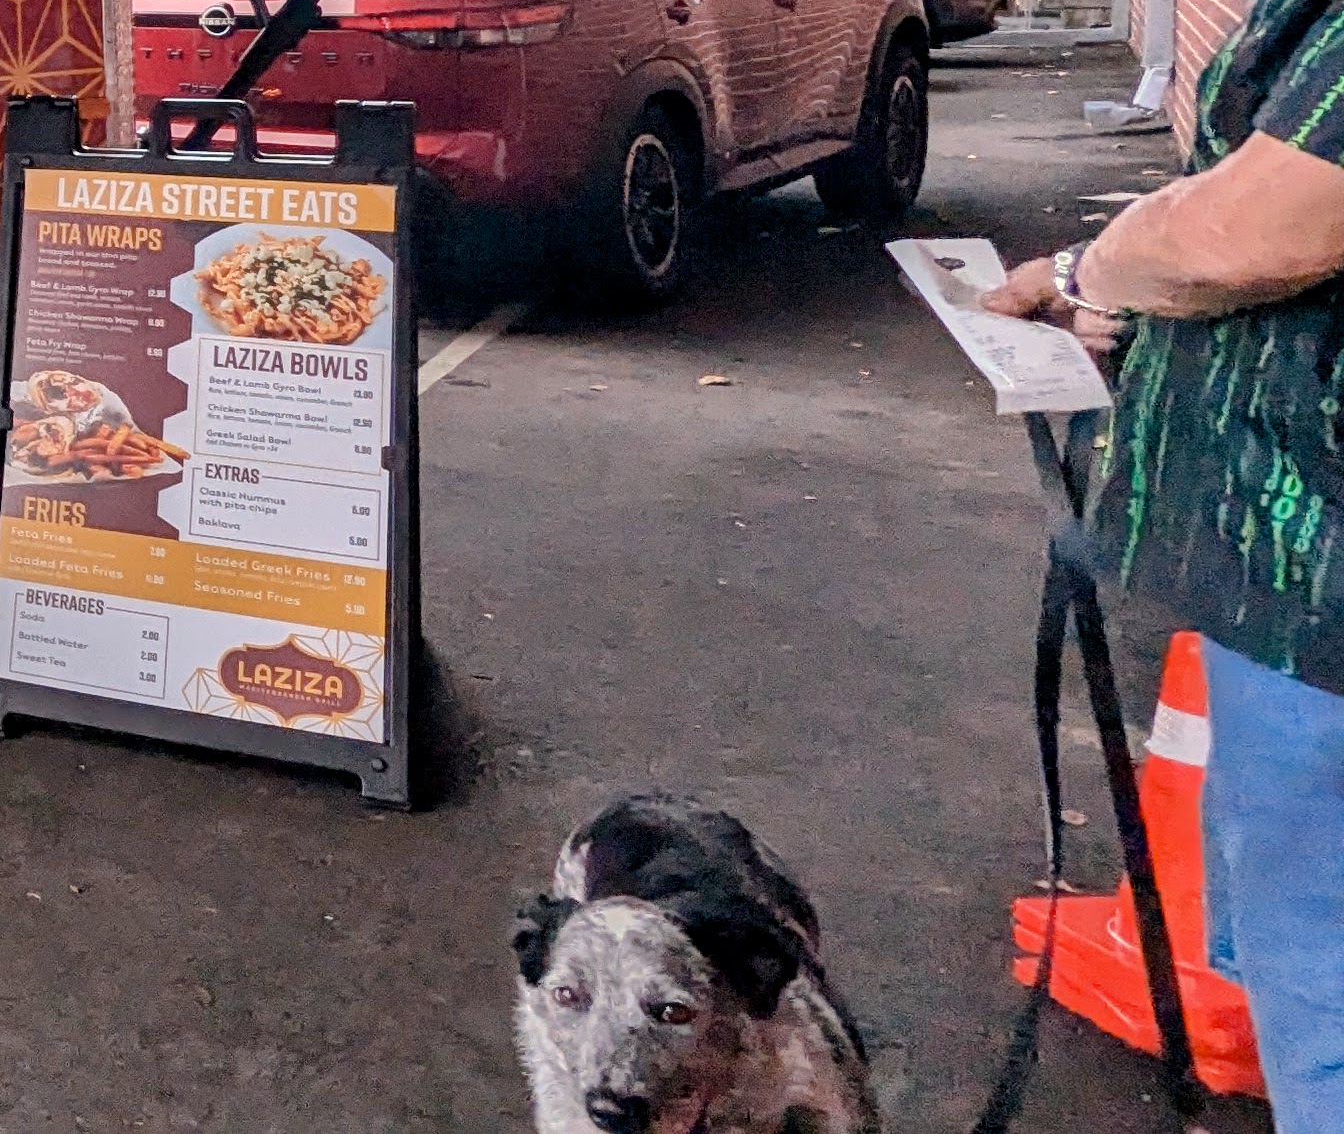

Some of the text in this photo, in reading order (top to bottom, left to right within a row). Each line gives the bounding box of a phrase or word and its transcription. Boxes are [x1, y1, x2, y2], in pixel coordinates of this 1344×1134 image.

[199, 16, 236, 26] NISSAN
[57, 177, 357, 225] LAZIZA STREET EATS
[38, 221, 162, 252] PITA WRAPS
[30, 280, 50, 290] Beef
[53, 282, 59, 290] &
[61, 283, 86, 292] Lamb
[88, 286, 108, 296] Gyro
[111, 288, 134, 298] Wrap
[29, 309, 62, 318] Chicken
[65, 312, 113, 323] Shawarma
[115, 317, 139, 326] Wrap
[27, 337, 47, 346] Feta
[48, 339, 61, 349] Fry
[64, 342, 87, 350] Wrap
[213, 345, 368, 382] LAZIZA BOWLS
[209, 376, 232, 385] Beef
[234, 378, 241, 386] &
[243, 379, 270, 389] Lamb
[273, 383, 296, 393] Gyro
[298, 385, 322, 394] Bowl
[208, 403, 246, 415] Chicken
[249, 407, 301, 421] Shawarma
[304, 413, 327, 423] Bowl
[206, 428, 234, 439] Greek
[237, 432, 265, 443] Salad
[269, 436, 291, 445] Bowl
[205, 463, 259, 484] EXTRAS
[199, 487, 286, 506] Classic Hummus
[23, 495, 87, 527] FRIES
[199, 498, 222, 508] with
[224, 500, 246, 511] pita
[249, 503, 277, 515] chips
[198, 517, 241, 530] Baklava
[12, 527, 39, 539] Feta
[43, 531, 73, 544] Fries
[9, 554, 56, 569] Loaded
[59, 560, 88, 574] Feta
[92, 565, 124, 579] Fries
[196, 553, 248, 569] Loaded
[251, 561, 291, 576] Greek
[296, 567, 331, 582] Fries
[26, 588, 104, 615] BEVERAGES
[194, 580, 262, 600] Seasoned
[267, 591, 301, 606] Fries
[20, 611, 45, 622] Soda
[18, 631, 55, 644] Bottled
[58, 637, 88, 650] Water
[16, 651, 46, 663] Sweet
[49, 657, 66, 667] Tea
[238, 660, 343, 699] LAZIZA
